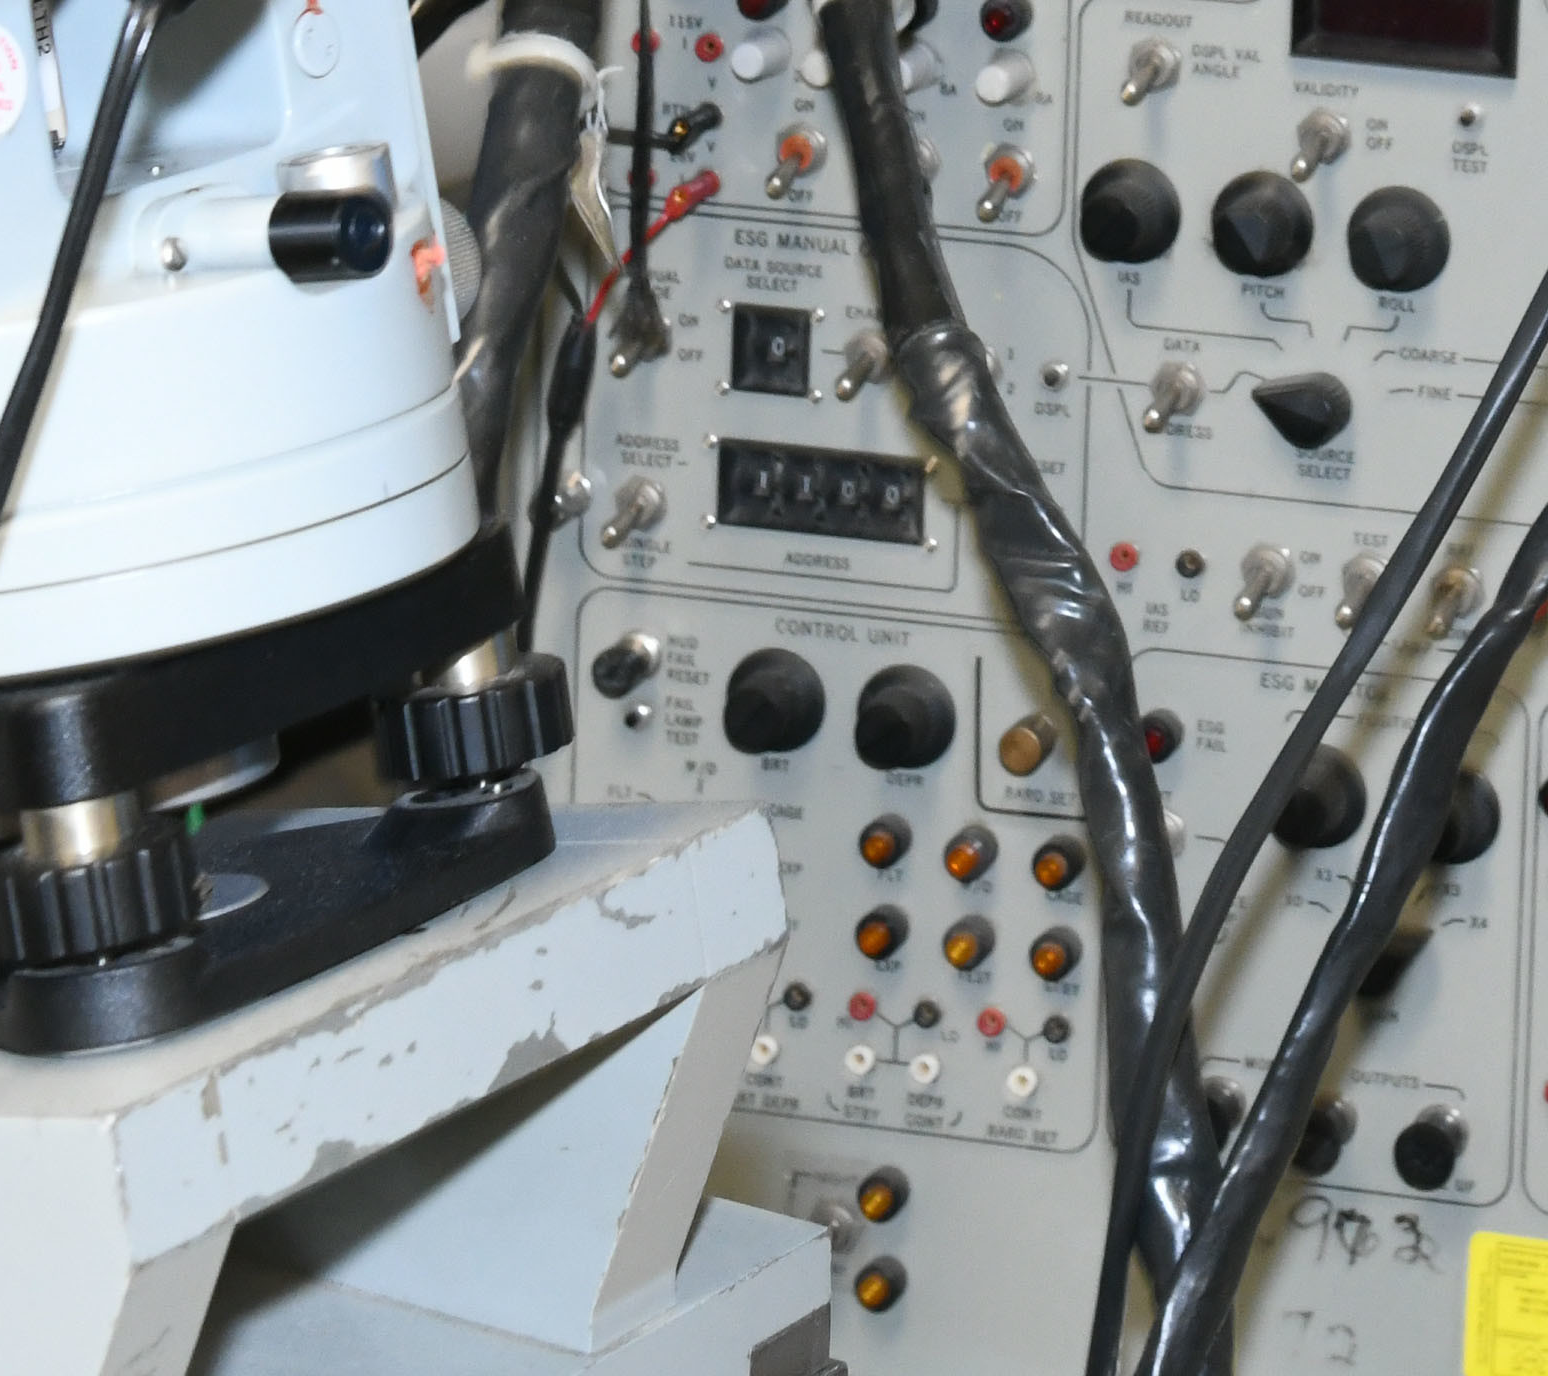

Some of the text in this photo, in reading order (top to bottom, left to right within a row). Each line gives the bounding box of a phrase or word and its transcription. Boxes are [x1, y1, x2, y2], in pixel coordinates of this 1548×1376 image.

[1124, 11, 1193, 29] READOUT
[1192, 63, 1241, 80] ANGLE
[1293, 82, 1359, 99] VALIDITY
[1453, 158, 1488, 174] TEST
[735, 229, 850, 255] ESG MANUAL
[746, 276, 798, 293] SELECT
[1241, 284, 1285, 301] PITCH
[1298, 464, 1351, 481] SELECT
[775, 618, 910, 646] CONTROL UNIT
[1260, 671, 1294, 691] ESG
